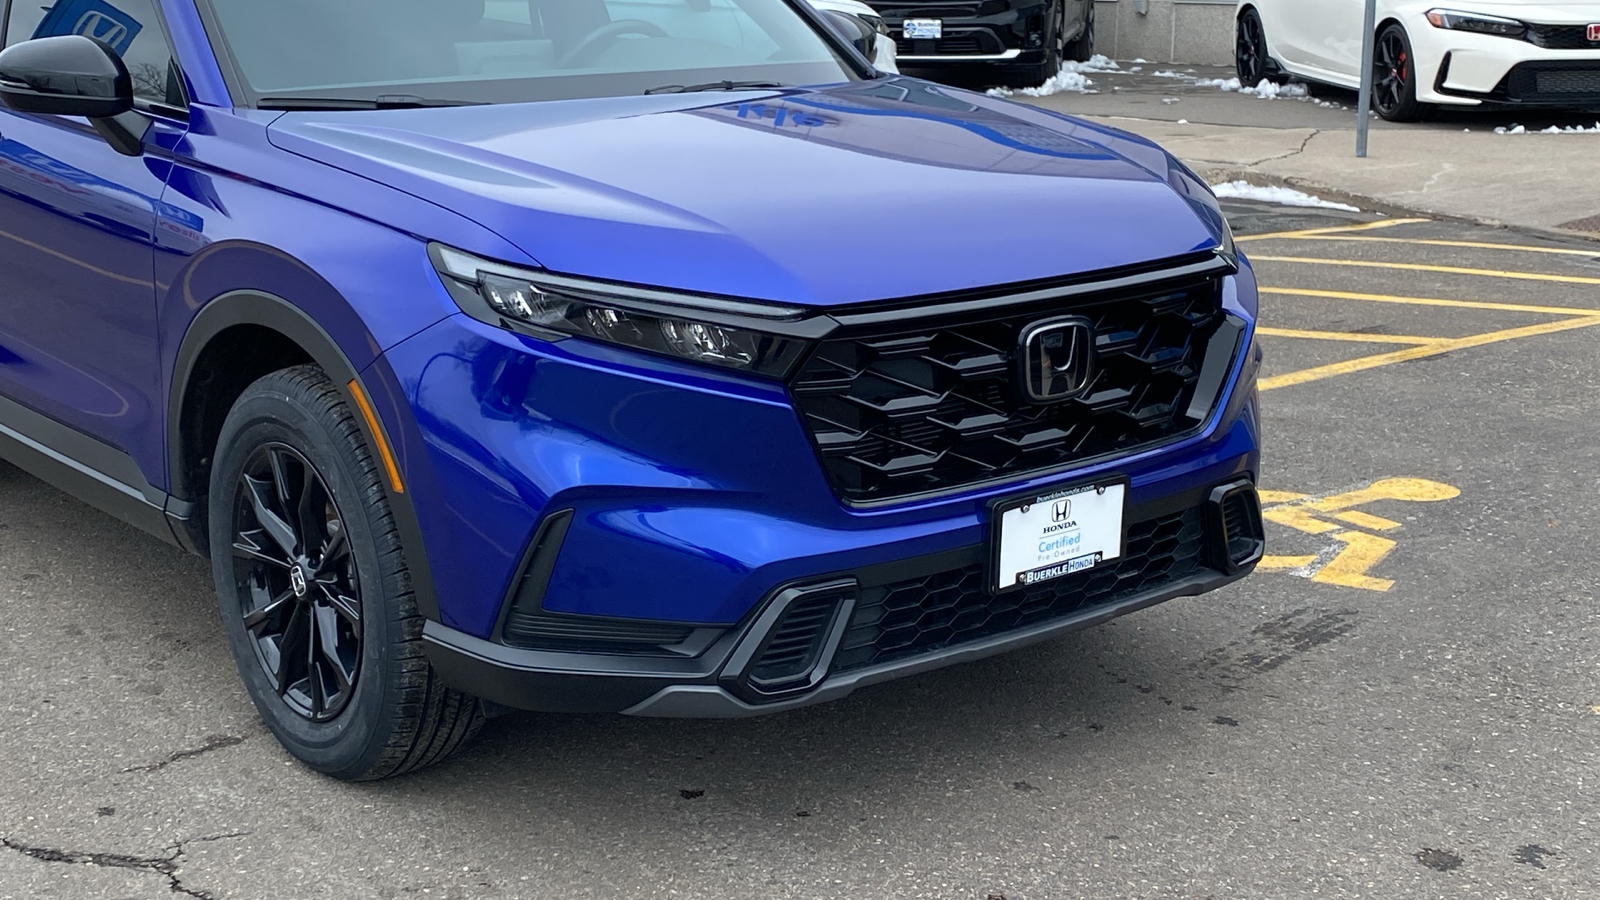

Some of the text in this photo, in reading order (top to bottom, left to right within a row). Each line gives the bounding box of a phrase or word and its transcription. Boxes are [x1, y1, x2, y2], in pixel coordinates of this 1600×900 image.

[1036, 485, 1095, 503] buerklehonda.com
[1043, 520, 1077, 534] HONDA
[1038, 532, 1081, 553] Certified
[1026, 558, 1093, 583] BUERKLE HONDA
